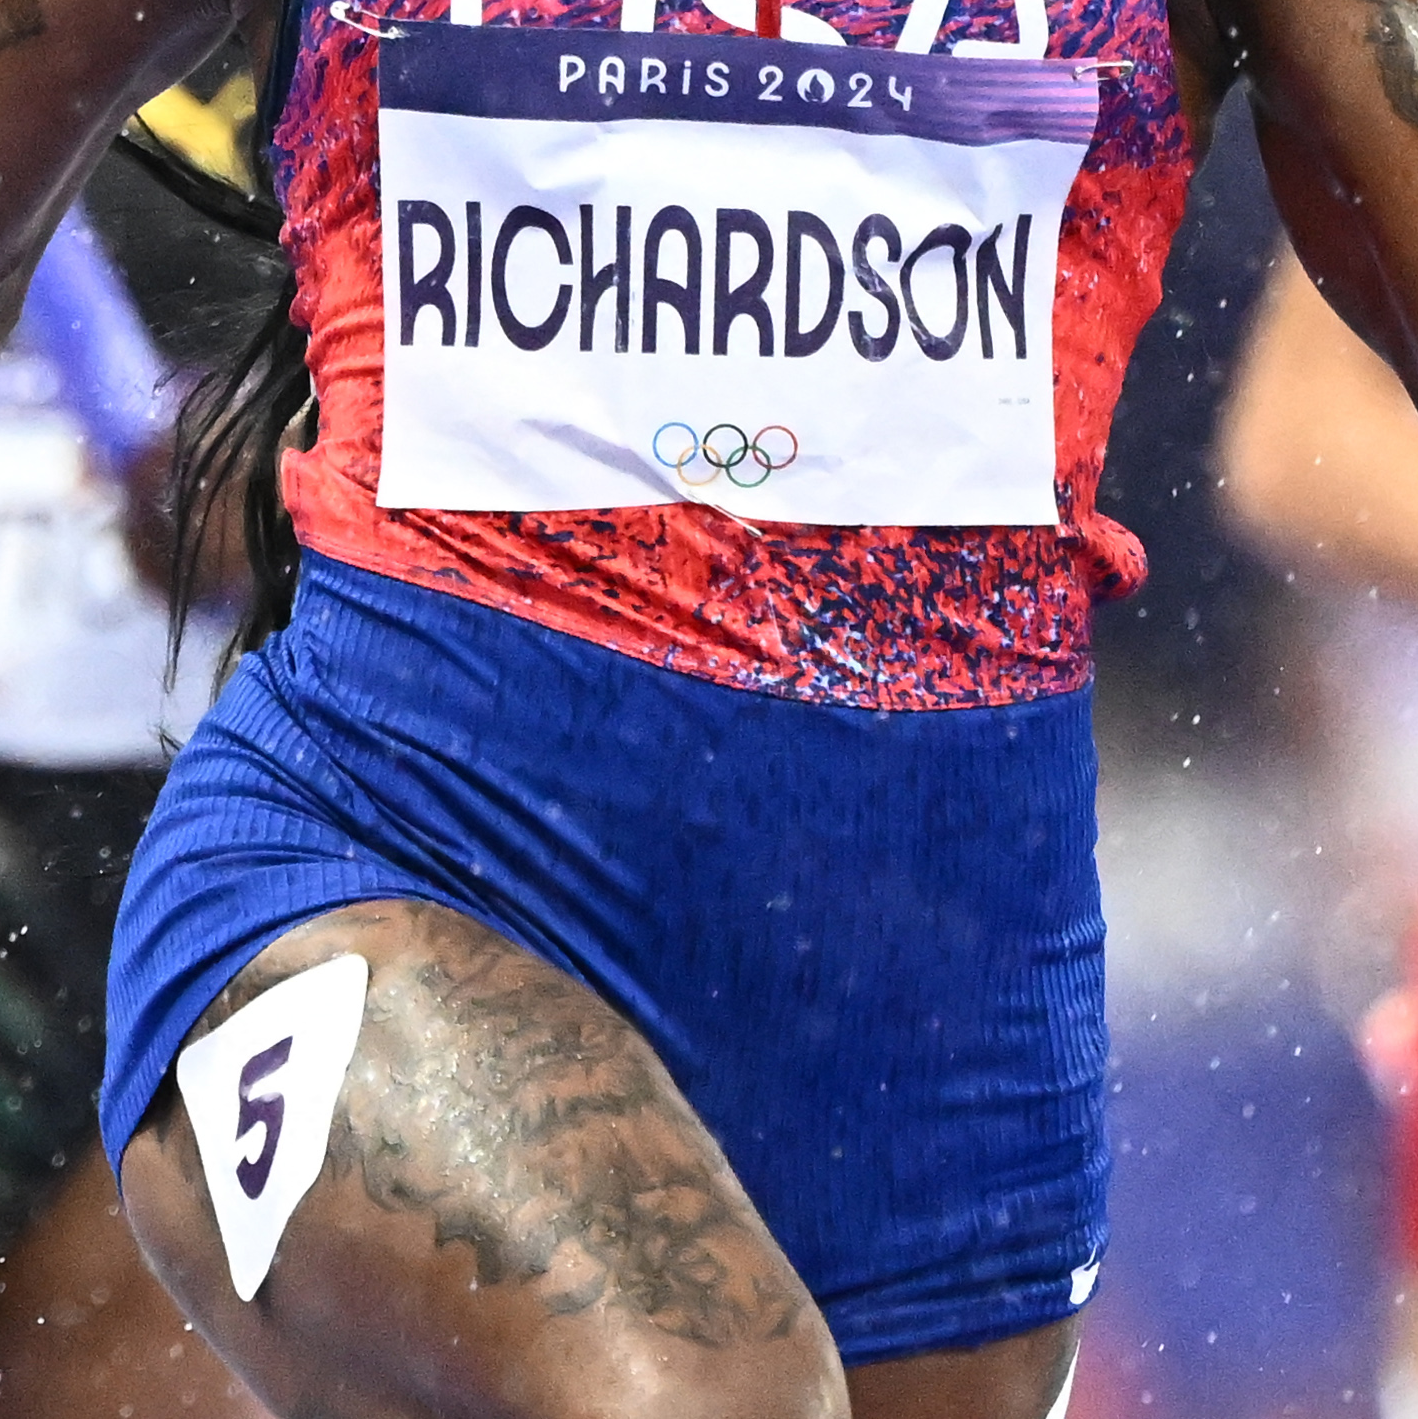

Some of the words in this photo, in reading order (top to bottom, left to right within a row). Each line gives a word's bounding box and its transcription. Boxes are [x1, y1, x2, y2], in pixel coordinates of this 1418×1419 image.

[757, 65, 913, 112] 2024
[397, 198, 1033, 362] RICHARDSON
[235, 1035, 293, 1200] 5
